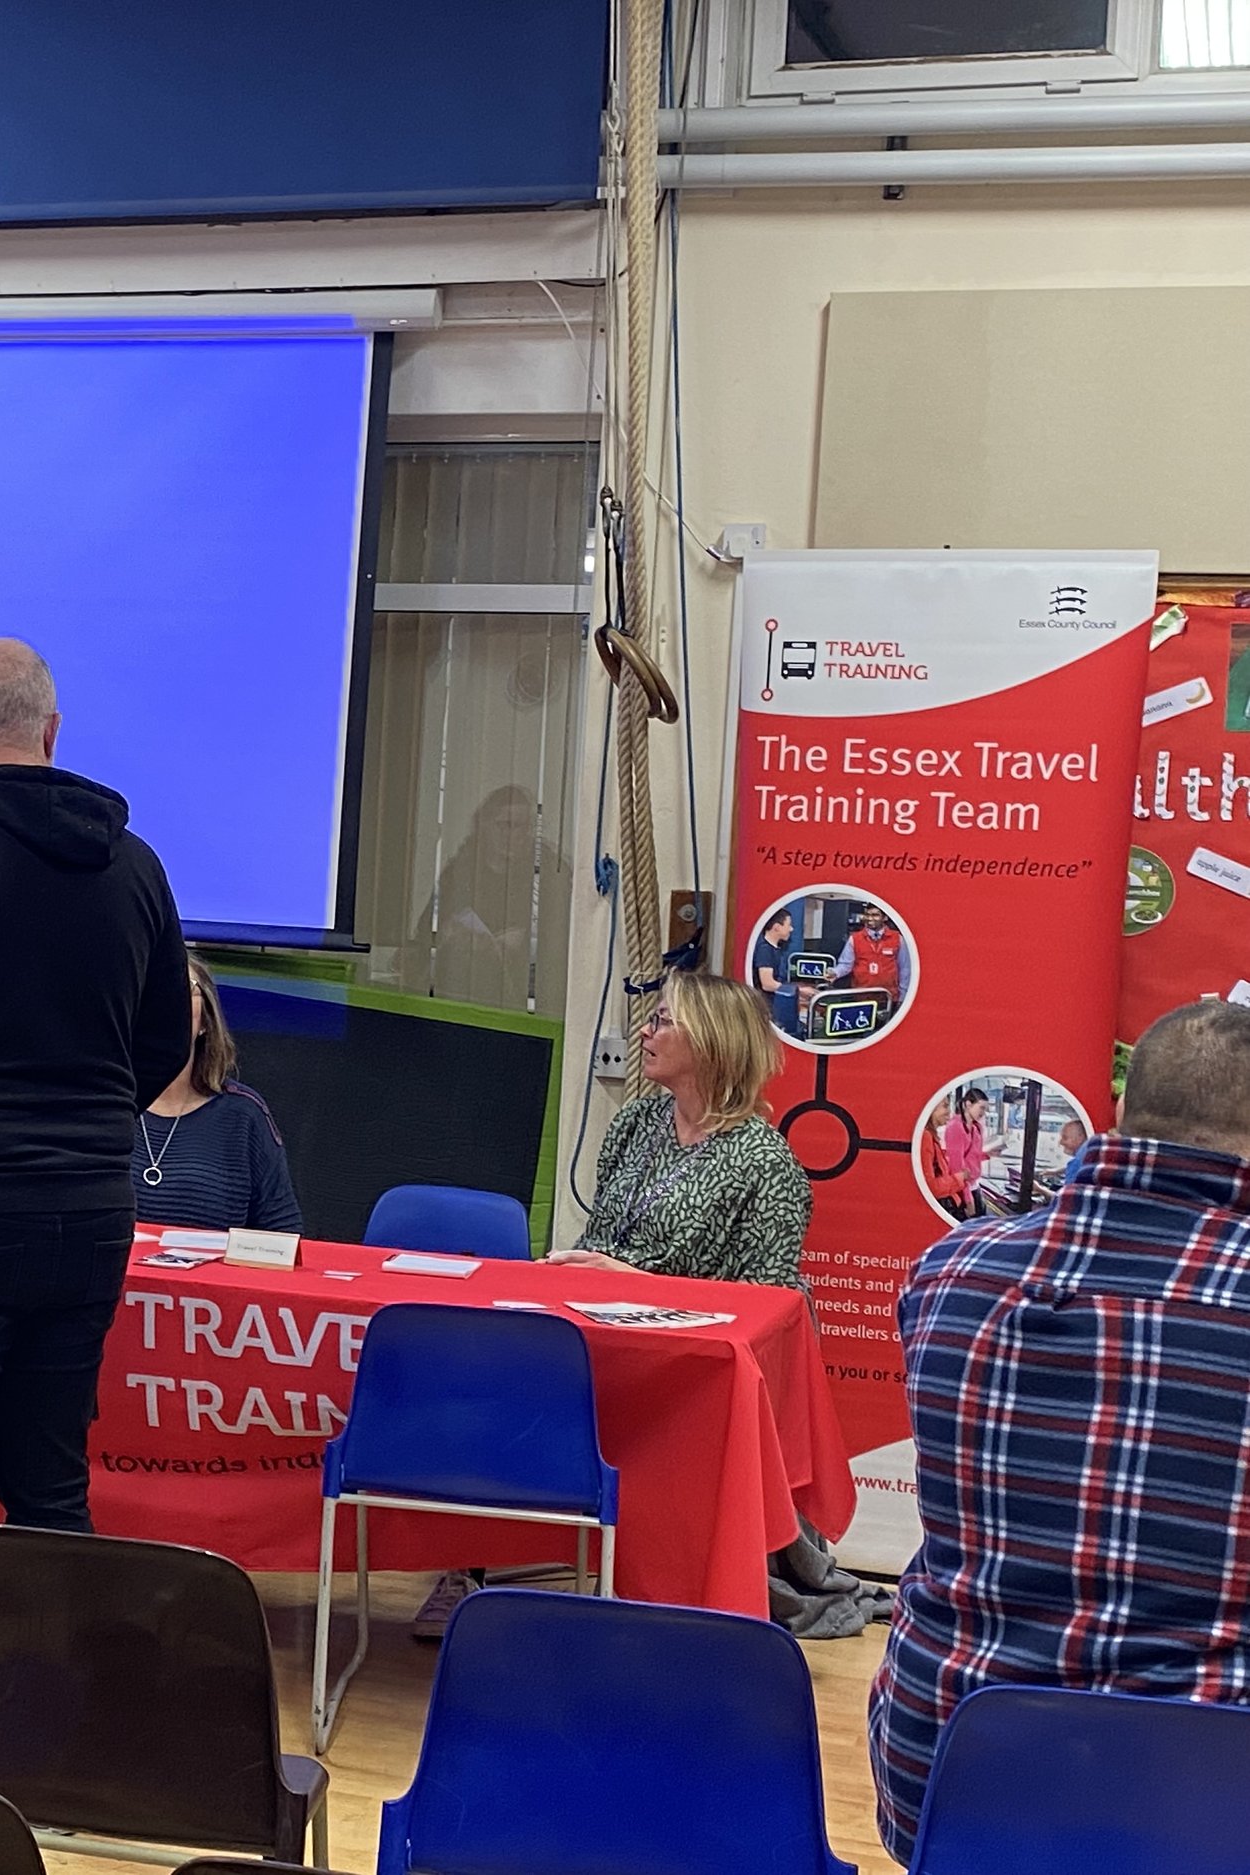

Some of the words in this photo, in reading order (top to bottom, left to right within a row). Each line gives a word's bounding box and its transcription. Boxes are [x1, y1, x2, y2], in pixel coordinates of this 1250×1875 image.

[1019, 618, 1047, 629] Essex
[1047, 618, 1080, 632] County
[1082, 619, 1117, 630] Council
[825, 641, 906, 658] TRAVEL
[823, 662, 929, 681] TRAINING
[756, 734, 828, 773] The
[843, 737, 963, 778] Essex
[973, 741, 1099, 783] Travel
[754, 785, 920, 835] Training
[930, 791, 1040, 832] Team
[781, 848, 827, 872] step
[832, 850, 919, 872] towards
[800, 1248, 831, 1263] eam
[834, 1250, 851, 1265] of
[853, 1252, 913, 1271] speciali
[865, 1279, 895, 1294] and
[815, 1299, 860, 1314] needs
[863, 1302, 892, 1317] and
[124, 1290, 372, 1373] TRAVE
[820, 1321, 889, 1342] travellers
[838, 1365, 868, 1380] you
[872, 1369, 890, 1381] or
[126, 1373, 349, 1437] TRAIN
[99, 1450, 248, 1475] towards
[854, 1475, 919, 1495] www.tra
